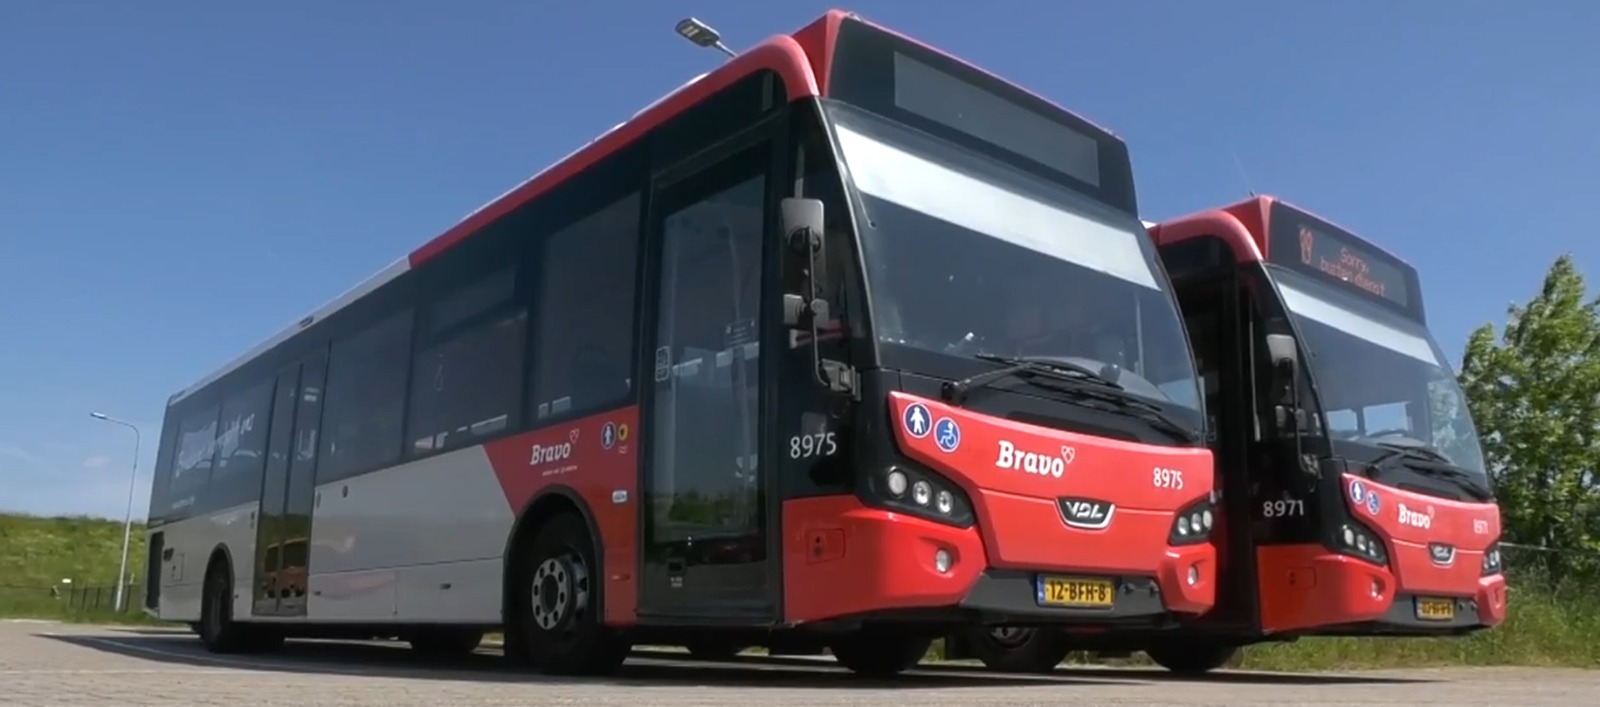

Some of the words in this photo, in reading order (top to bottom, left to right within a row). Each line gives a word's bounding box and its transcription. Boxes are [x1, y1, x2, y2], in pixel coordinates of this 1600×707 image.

[529, 442, 571, 465] Bravo
[789, 432, 837, 459] 8975
[996, 440, 1065, 478] Bravo
[1153, 467, 1184, 490] 8975
[1065, 500, 1106, 518] VDL
[1263, 500, 1304, 517] 8971
[1398, 503, 1431, 529] Bravo
[1049, 580, 1107, 602] 12-BFH-8
